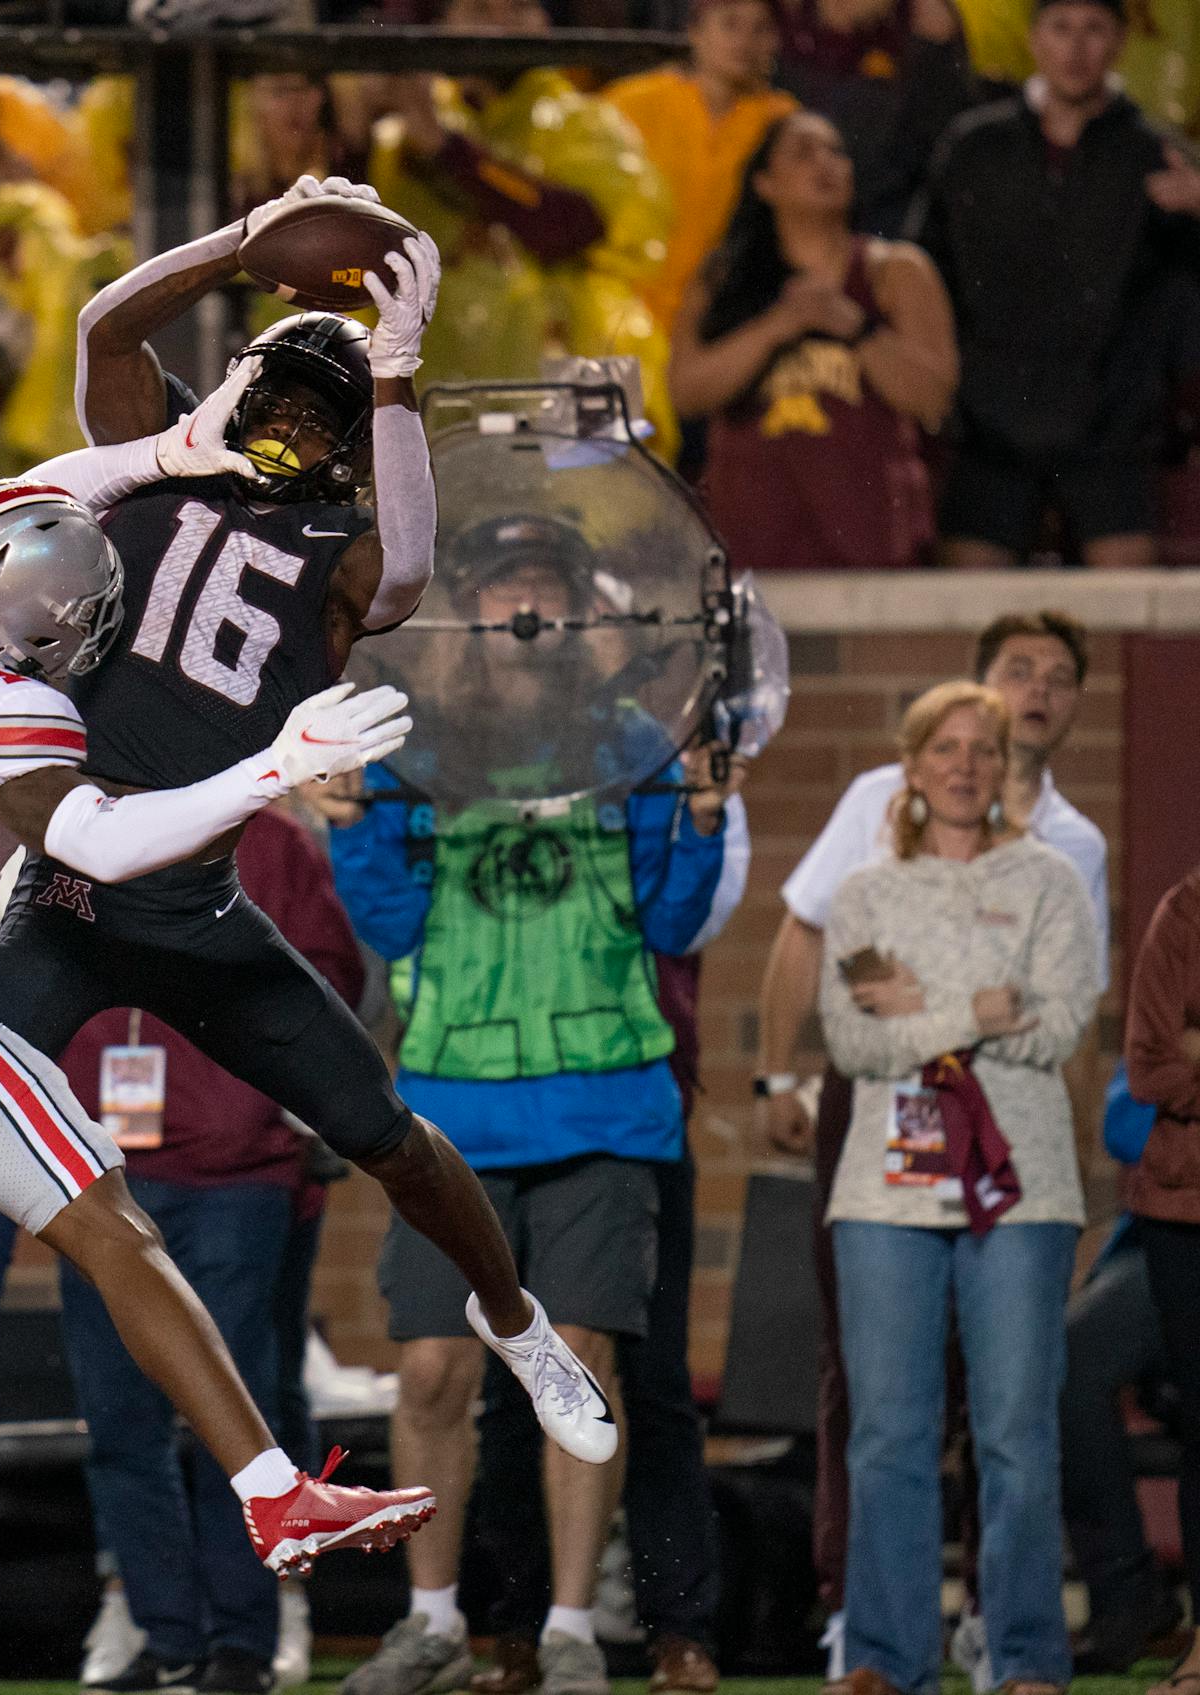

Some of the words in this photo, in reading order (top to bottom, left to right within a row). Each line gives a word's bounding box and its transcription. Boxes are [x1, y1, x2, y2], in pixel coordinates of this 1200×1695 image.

[130, 500, 306, 706] 16
[36, 873, 95, 922] M
[280, 1519, 310, 1528] VAPOR
